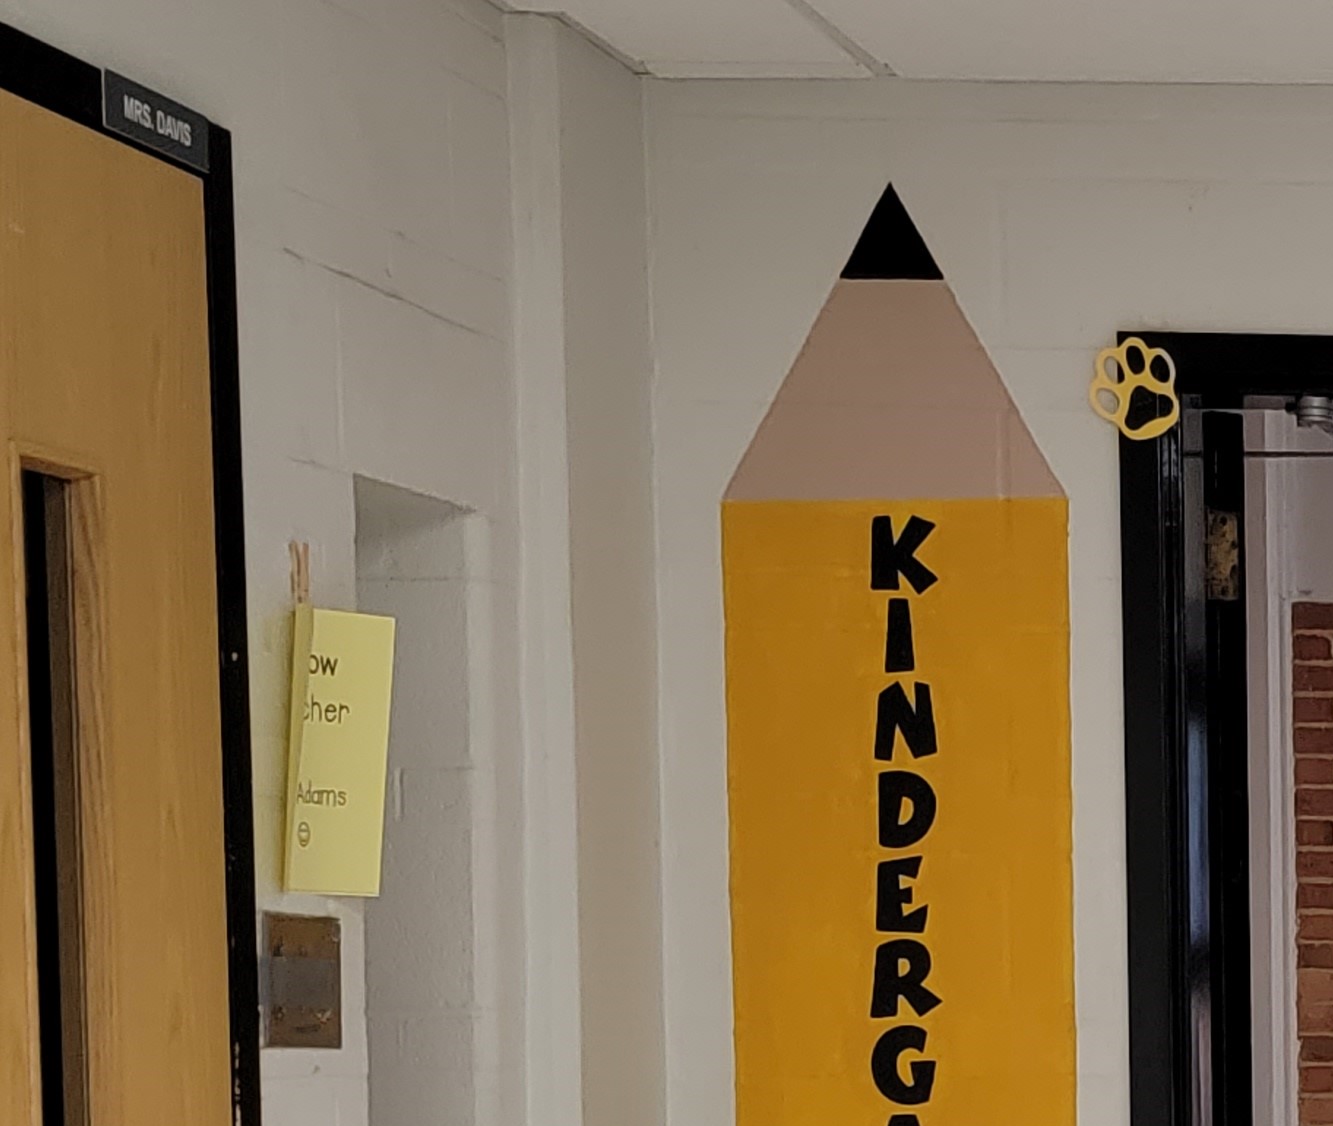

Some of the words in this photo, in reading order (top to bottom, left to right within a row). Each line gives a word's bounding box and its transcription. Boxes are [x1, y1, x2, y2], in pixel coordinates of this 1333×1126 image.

[123, 94, 154, 131] MRS.
[156, 110, 192, 147] DAVIS
[296, 779, 347, 808] Adams
